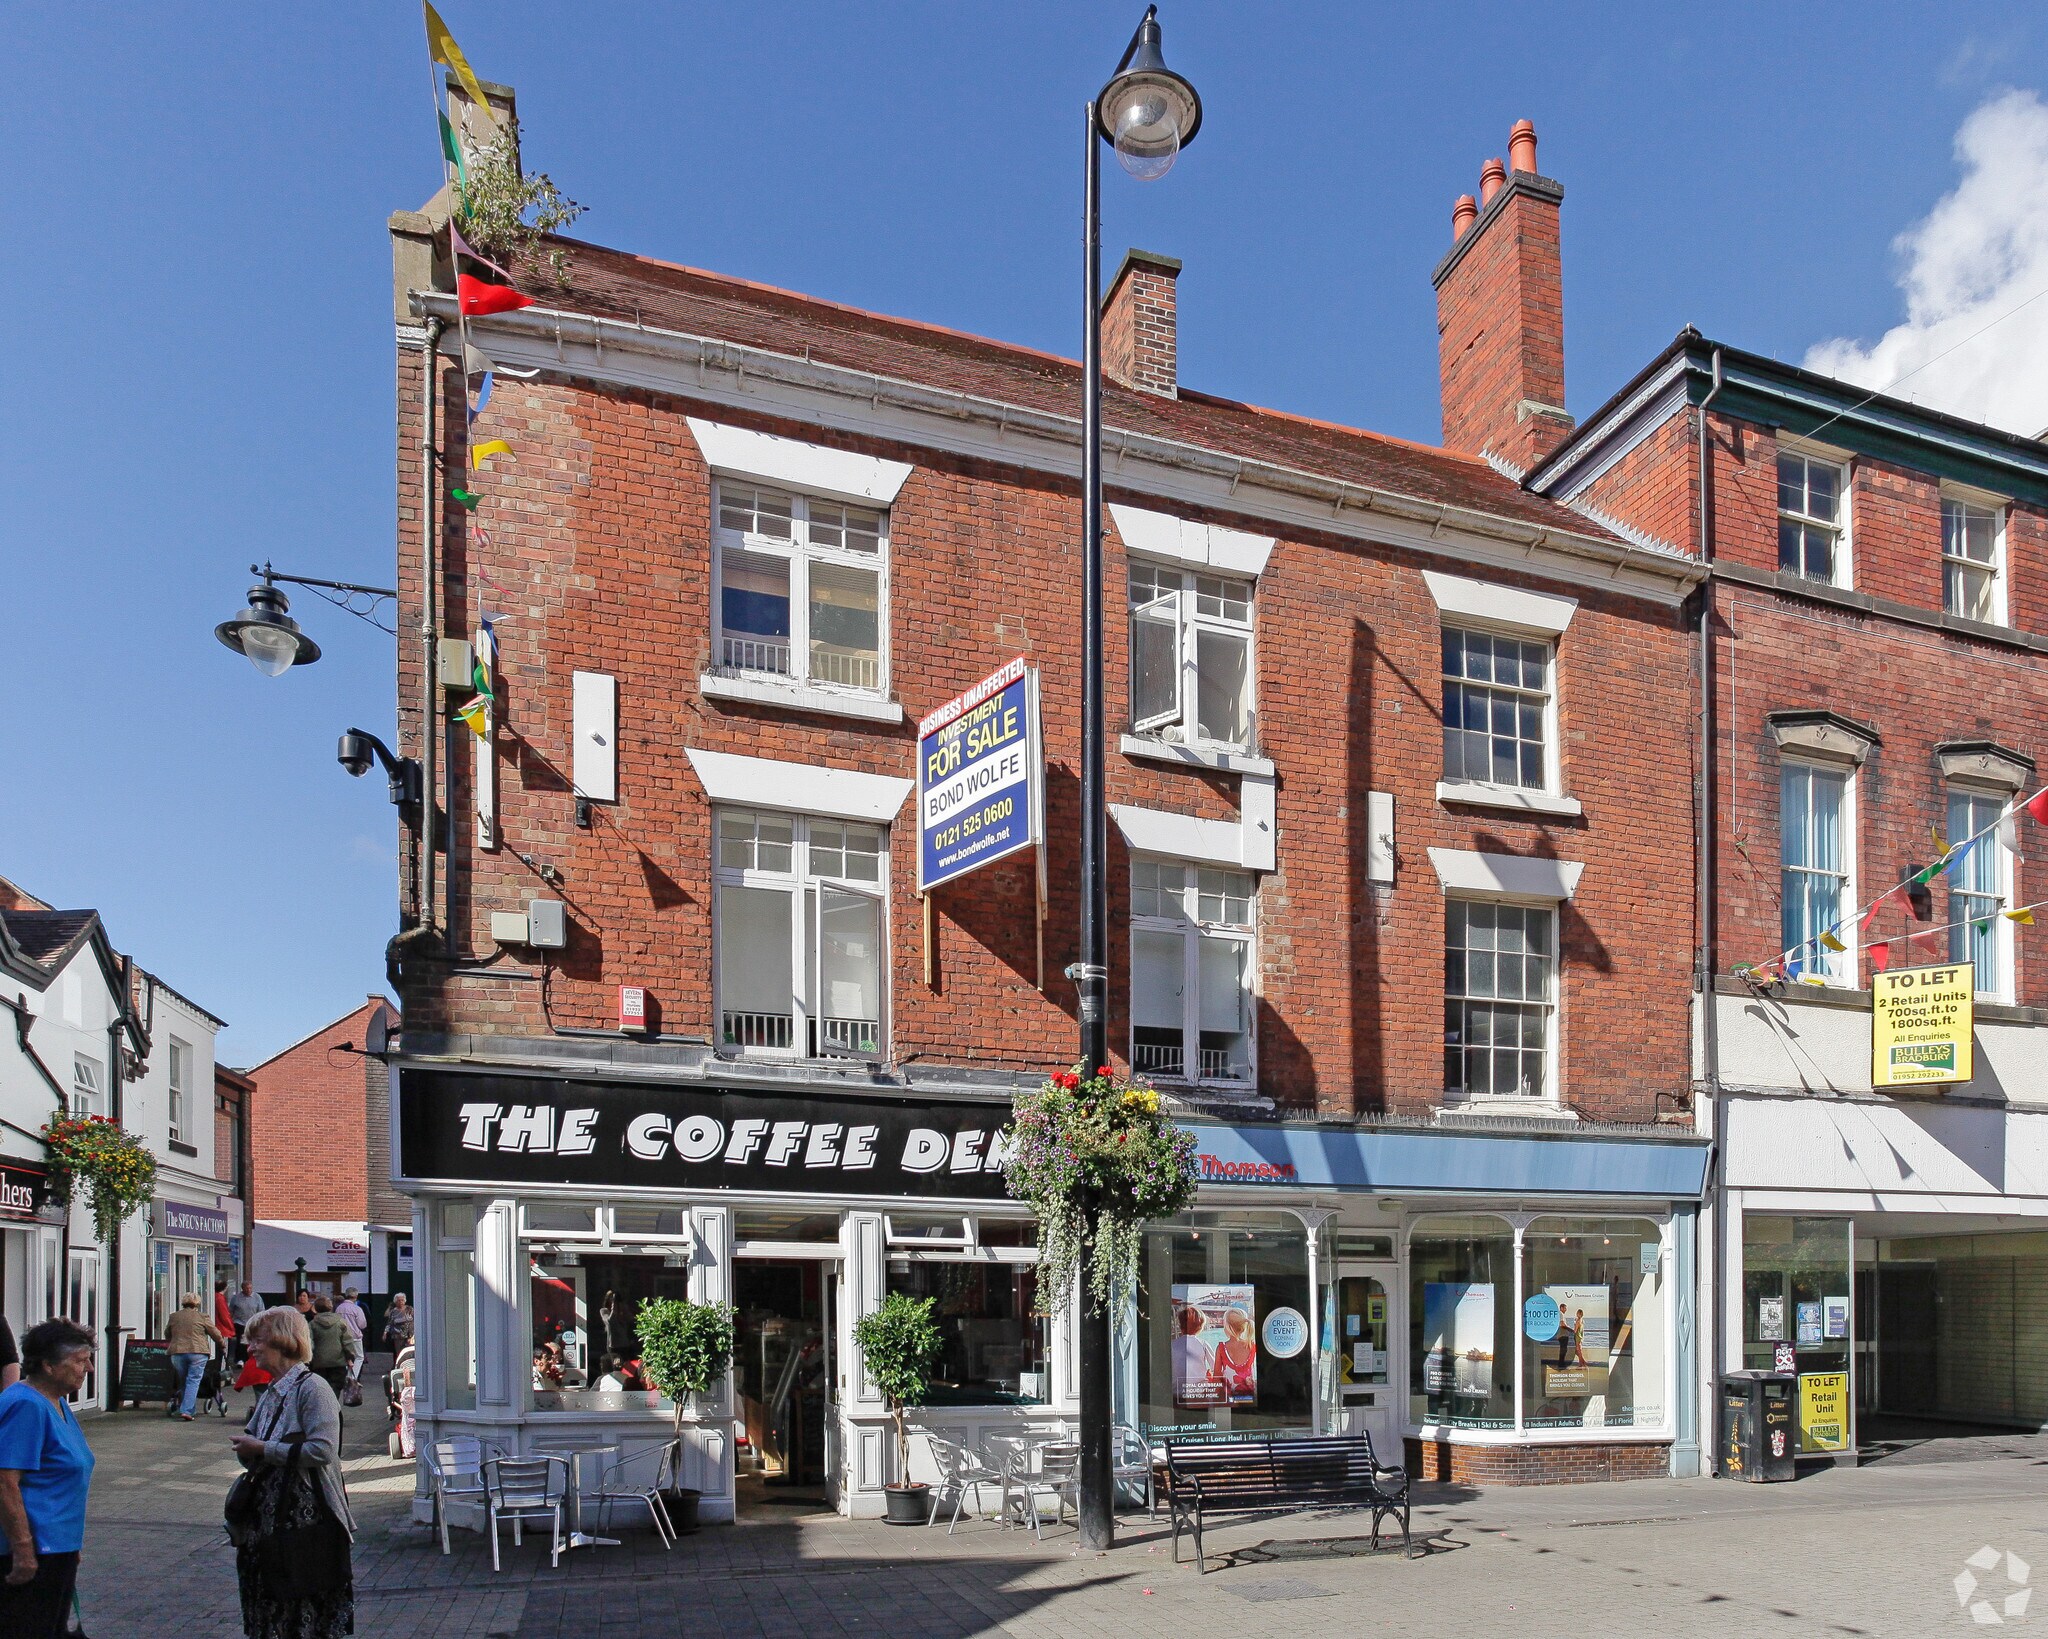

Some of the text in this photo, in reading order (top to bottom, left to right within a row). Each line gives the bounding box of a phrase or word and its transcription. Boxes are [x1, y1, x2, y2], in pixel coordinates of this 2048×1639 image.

[920, 657, 1024, 736] BUSINESS UNAFFECTED
[938, 692, 1005, 746] INVESTMENT
[928, 706, 1018, 784] FOR SALE
[930, 753, 1019, 817] BOND WOLFE
[935, 797, 1013, 851] 0121 525 0600
[938, 826, 1011, 868] www.bondwolfe.net
[1886, 969, 1958, 989] TO LET
[1879, 991, 1967, 1008] 2 Retail Units
[1894, 1032, 1951, 1043] All Enquiries
[1895, 1044, 1951, 1057] BULLEYS
[1895, 1053, 1950, 1063] BRADBURY
[459, 1103, 599, 1156] THE
[627, 1113, 880, 1170] COFFEE
[1197, 1154, 1295, 1177] Thomson
[167, 1210, 226, 1234] The SPEC'S FACTORY
[332, 1240, 361, 1250] Cafe
[1544, 1310, 1558, 1318] OFF
[1807, 1377, 1840, 1388] TO LET
[1811, 1392, 1837, 1402] Retail
[1816, 1404, 1834, 1413] Unit
[1148, 1421, 1217, 1432] Discover your smile
[1481, 1421, 1491, 1429] Ski
[1531, 1420, 1553, 1428] Inclusive
[1558, 1419, 1575, 1427] Adults
